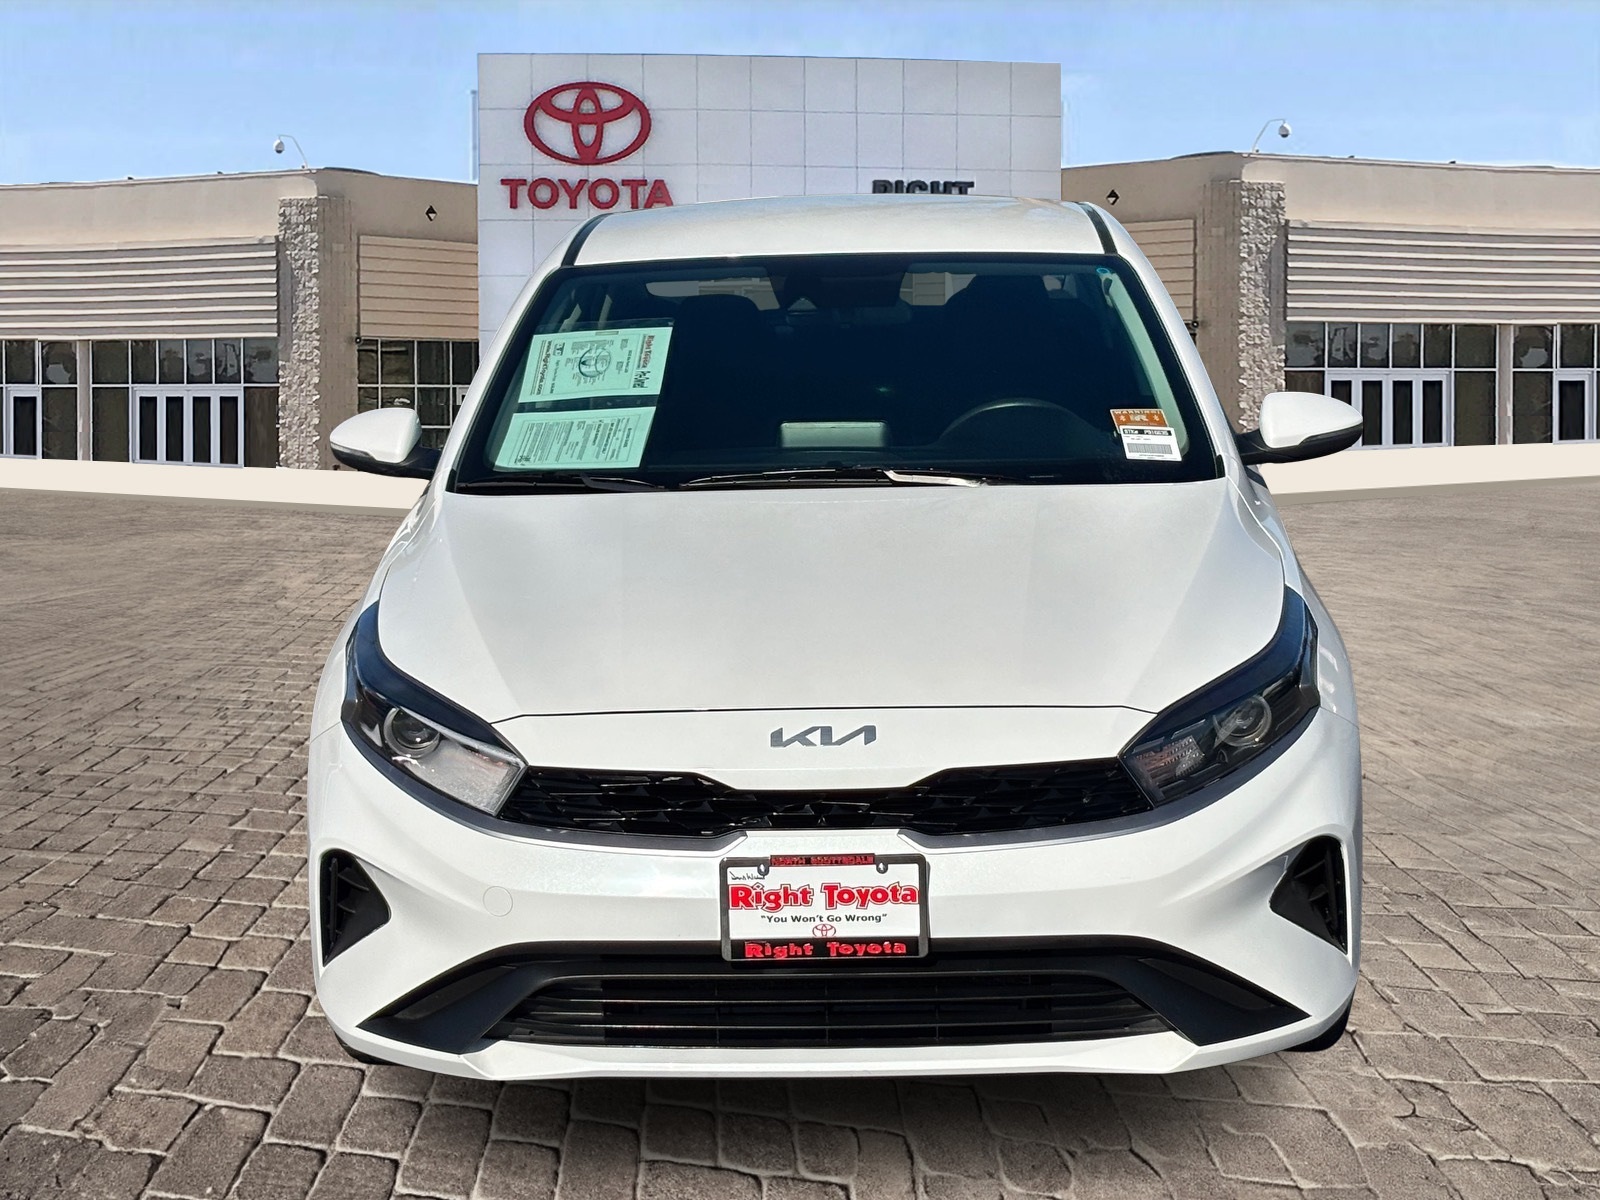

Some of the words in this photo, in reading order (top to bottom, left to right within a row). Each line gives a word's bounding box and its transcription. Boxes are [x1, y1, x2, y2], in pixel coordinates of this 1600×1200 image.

[500, 177, 674, 210] TOYOTA
[770, 724, 877, 748] KIA
[728, 882, 815, 913] Right
[820, 881, 920, 910] Toyota
[827, 914, 842, 923] Go
[744, 941, 814, 959] Right
[826, 941, 907, 957] Toyota
